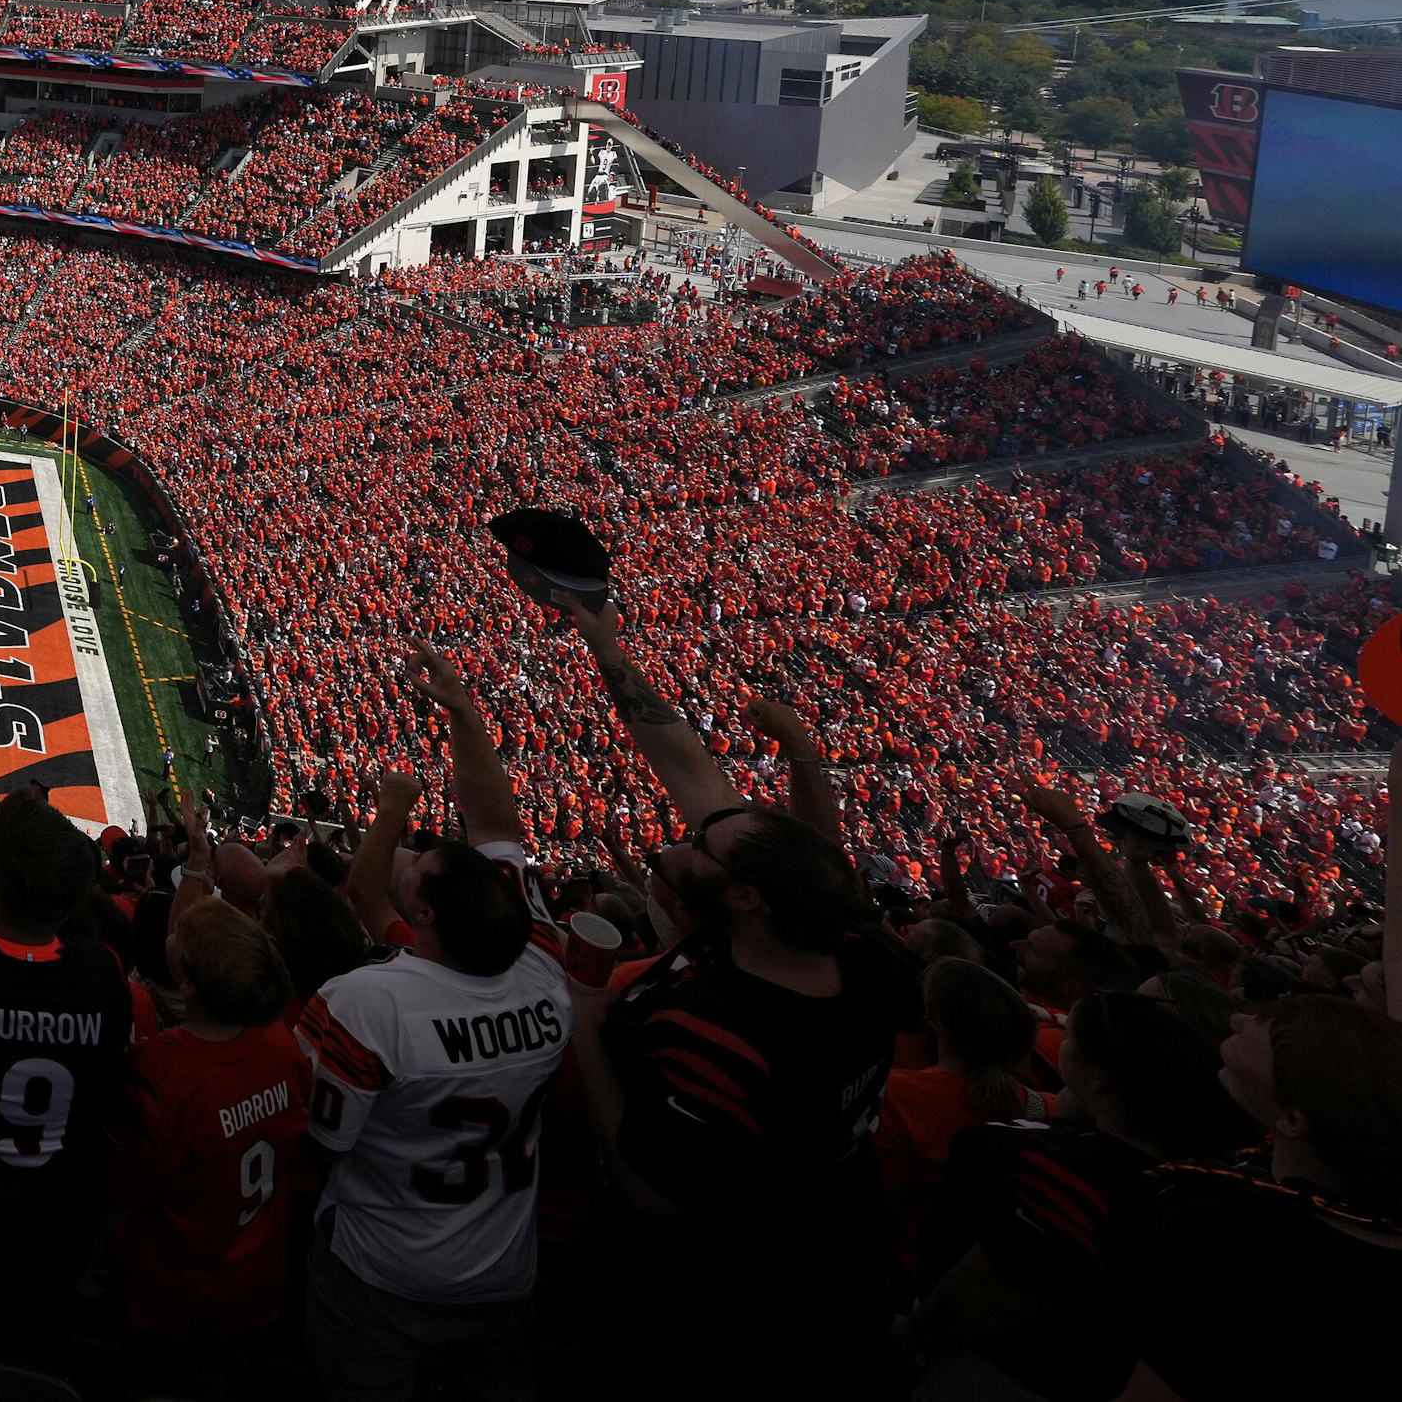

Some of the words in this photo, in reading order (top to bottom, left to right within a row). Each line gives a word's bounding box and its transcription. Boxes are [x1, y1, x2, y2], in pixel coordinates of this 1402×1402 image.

[57, 558, 89, 612] CHOOSE
[69, 615, 100, 656] LOVE
[432, 998, 563, 1064] WOODS
[217, 1079, 291, 1139] BURROW
[311, 1078, 345, 1131] 0
[237, 1139, 277, 1228] 9
